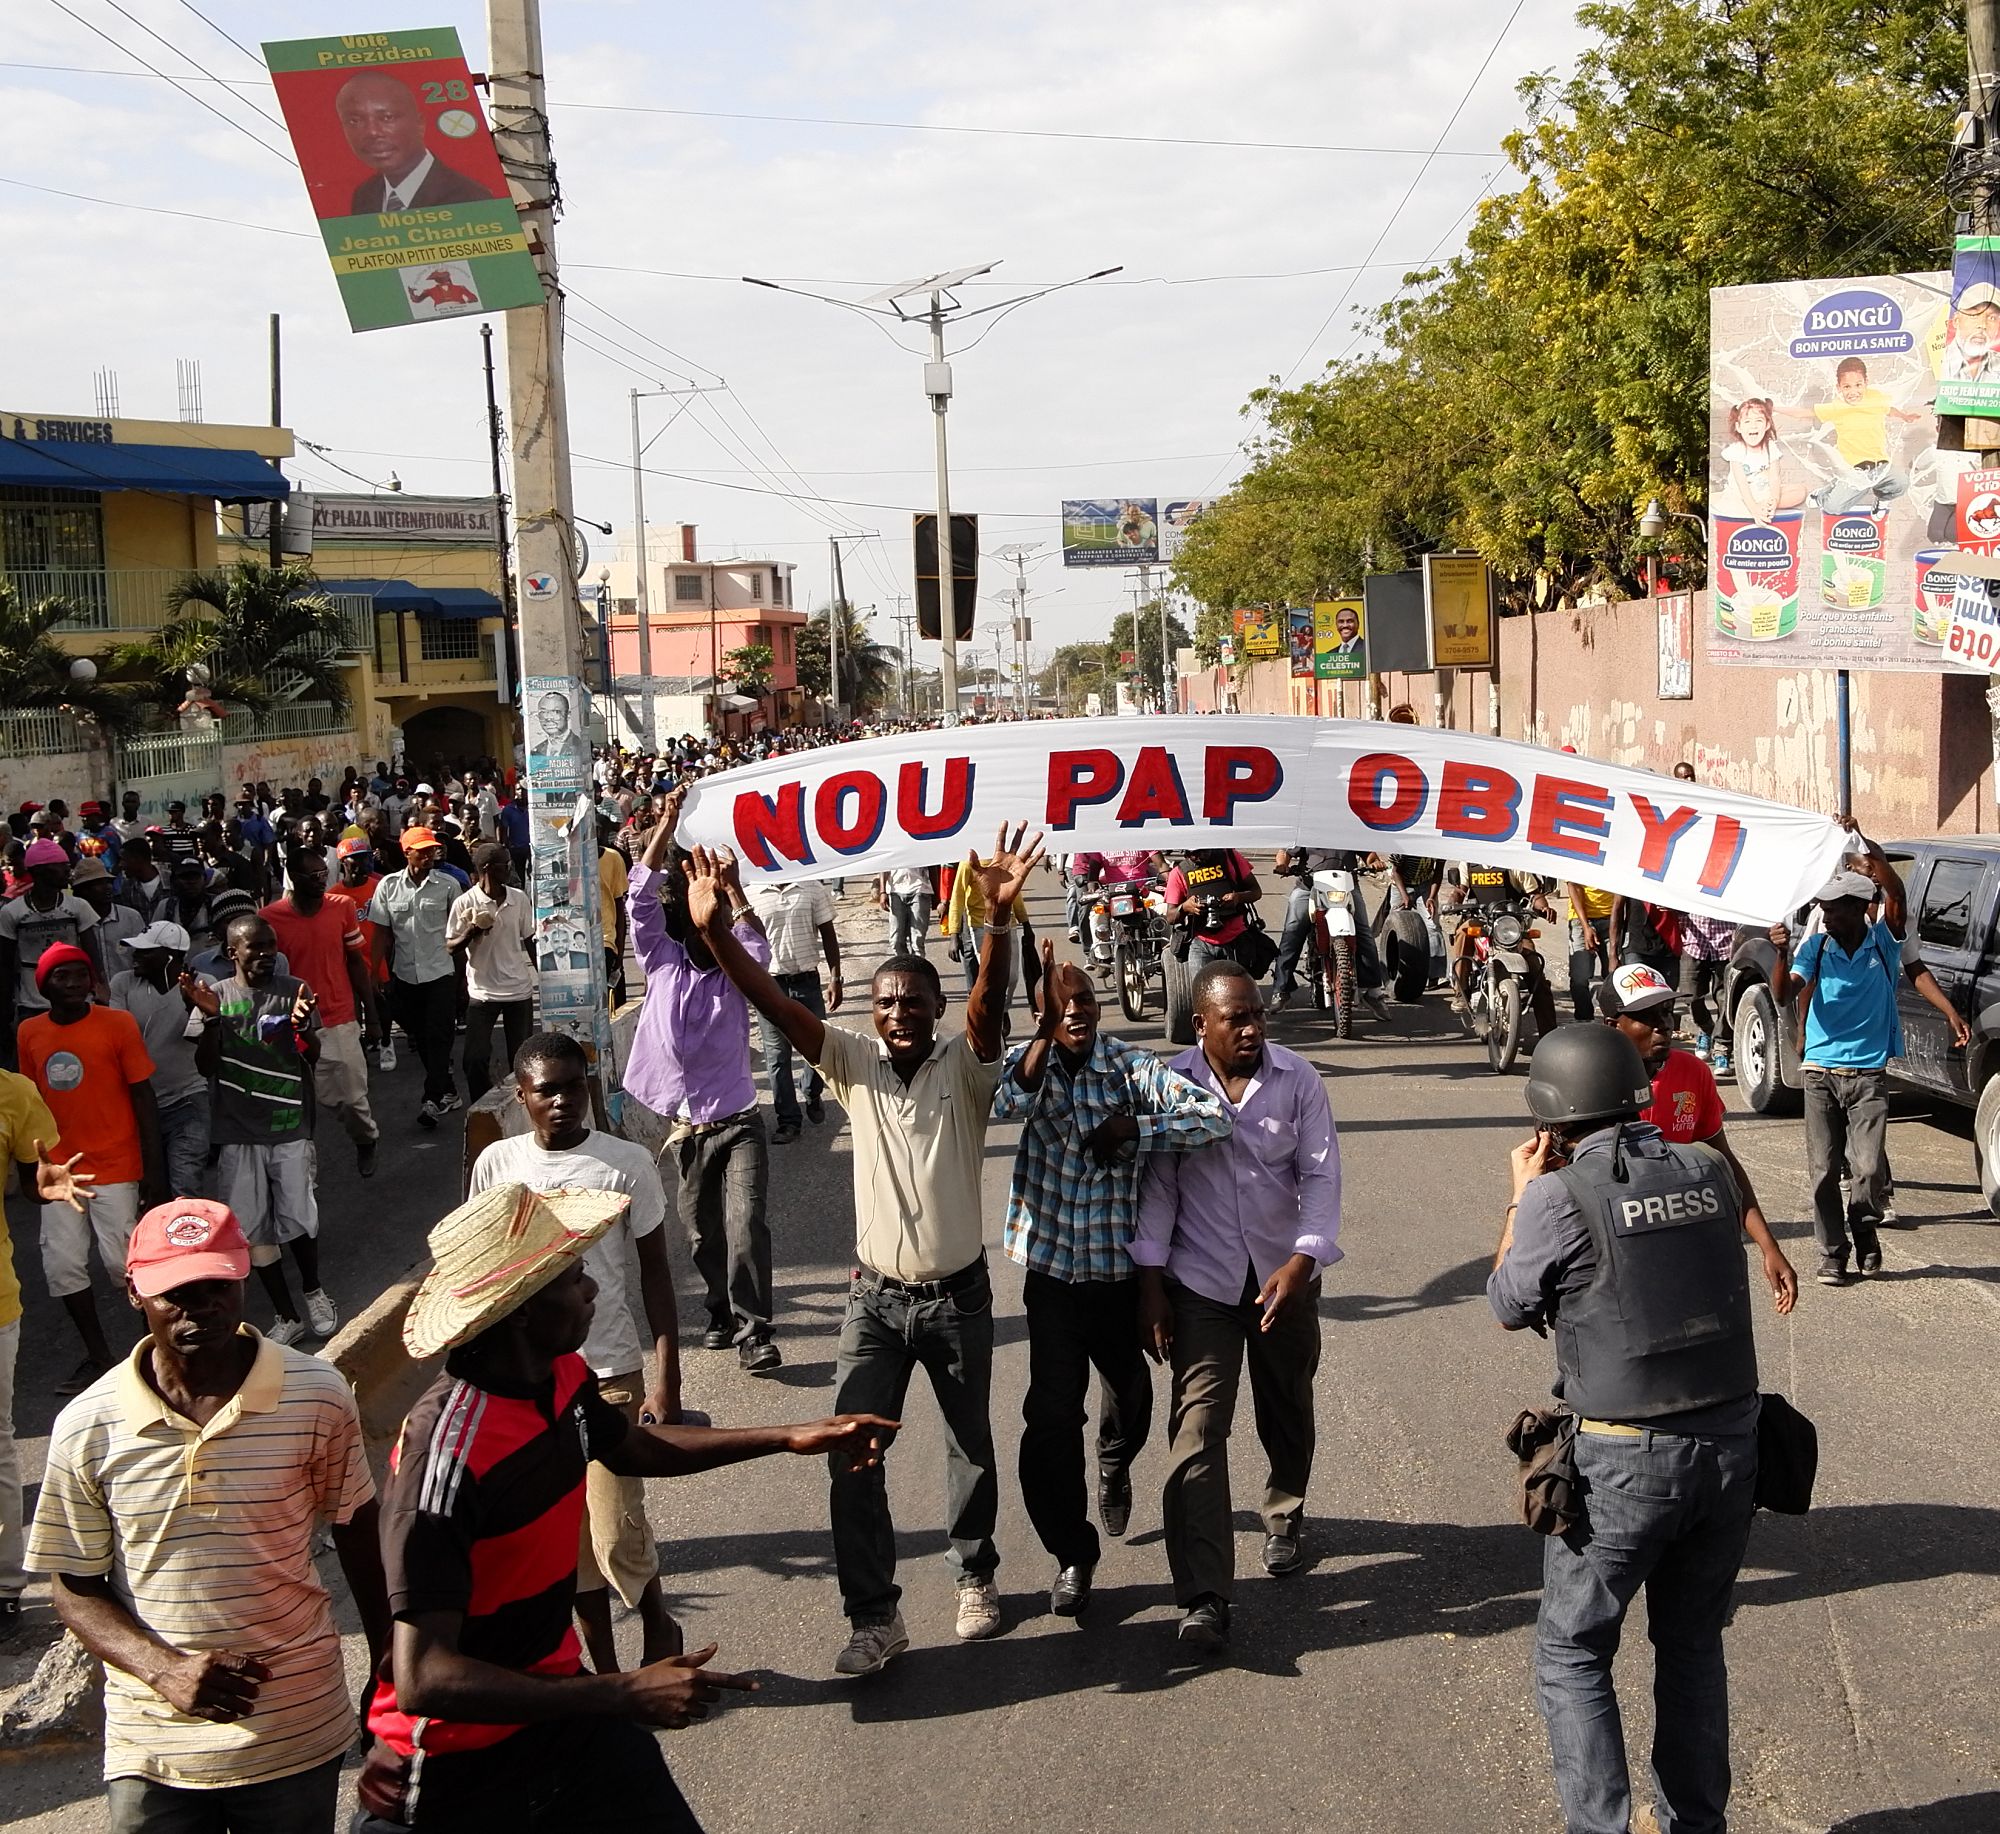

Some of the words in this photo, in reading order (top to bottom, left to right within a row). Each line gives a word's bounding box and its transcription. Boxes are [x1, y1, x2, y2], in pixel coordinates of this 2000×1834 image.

[340, 32, 388, 49] Vote
[317, 44, 432, 66] Prezidan
[421, 79, 470, 104] 28
[378, 208, 453, 229] Moise
[339, 233, 400, 251] Jean
[407, 220, 503, 244] Charles
[347, 251, 405, 270] PLATFOM
[408, 248, 436, 263] PITIT
[439, 238, 514, 259] DESSALINES
[1811, 302, 1892, 330] BONGÚ
[1795, 342, 1819, 353] BON
[1821, 339, 1851, 352] POUR
[1853, 338, 1868, 350] LA
[1870, 334, 1907, 348] SANTÉ
[14, 418, 26, 440] &
[36, 419, 113, 444] SERVICES
[332, 510, 371, 527] PLAZA
[374, 510, 466, 529] INTERNATIONAL
[468, 513, 490, 530] S.A.
[1835, 526, 1873, 538] BONGÚ
[1732, 537, 1783, 552] BONGÚ
[1800, 611, 1820, 620] Pour
[1822, 613, 1840, 624] que
[1860, 612, 1894, 622] enfants
[1820, 625, 1873, 636] grandissent
[1823, 639, 1852, 647] bonne
[1320, 662, 1360, 670] CELESTIN
[733, 756, 973, 872] NOU
[1046, 746, 1284, 831] PAP
[1348, 752, 1747, 898] OBEYI
[1187, 864, 1224, 885] PRESS
[1471, 872, 1504, 885] PRESS
[1621, 1187, 1719, 1228] PRESS
